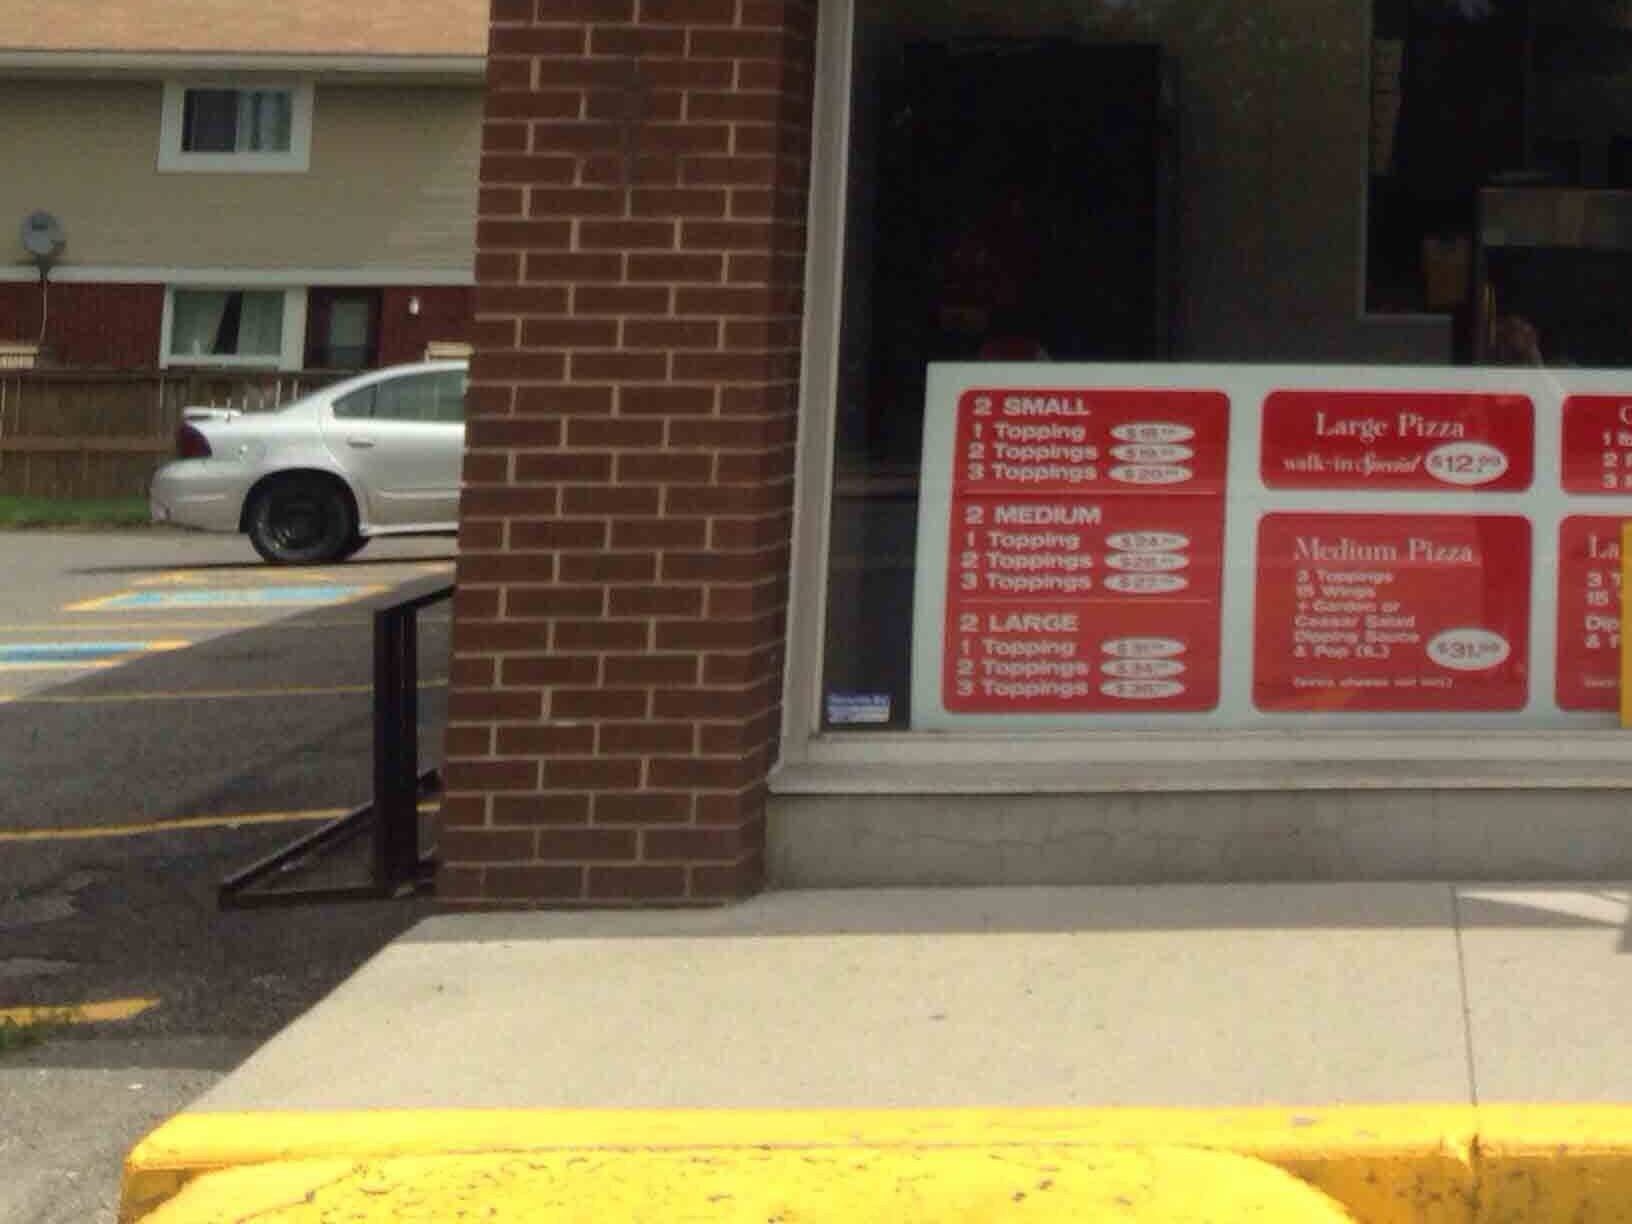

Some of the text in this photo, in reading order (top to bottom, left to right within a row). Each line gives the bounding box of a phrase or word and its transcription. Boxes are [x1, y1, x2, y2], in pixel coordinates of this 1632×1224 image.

[973, 397, 1090, 416] 2 SMALL
[994, 424, 1086, 441] Topping
[1315, 412, 1464, 442] Large Pizza
[968, 443, 985, 460] 2
[993, 444, 1099, 462] Toppings
[968, 465, 985, 481] 3
[993, 465, 1099, 483] Toppings
[965, 506, 1101, 525] 2 MEDIUM
[987, 532, 1081, 551] Topping
[1294, 537, 1474, 563] Medium Pizza
[961, 553, 1094, 572] 2 Toppings
[961, 574, 978, 590] 3
[986, 575, 1092, 593] Toppings
[960, 615, 1079, 633] 2 LARGE
[982, 639, 1076, 658] Topping
[982, 660, 1089, 679] Toppings
[982, 681, 1089, 699] Toppings
